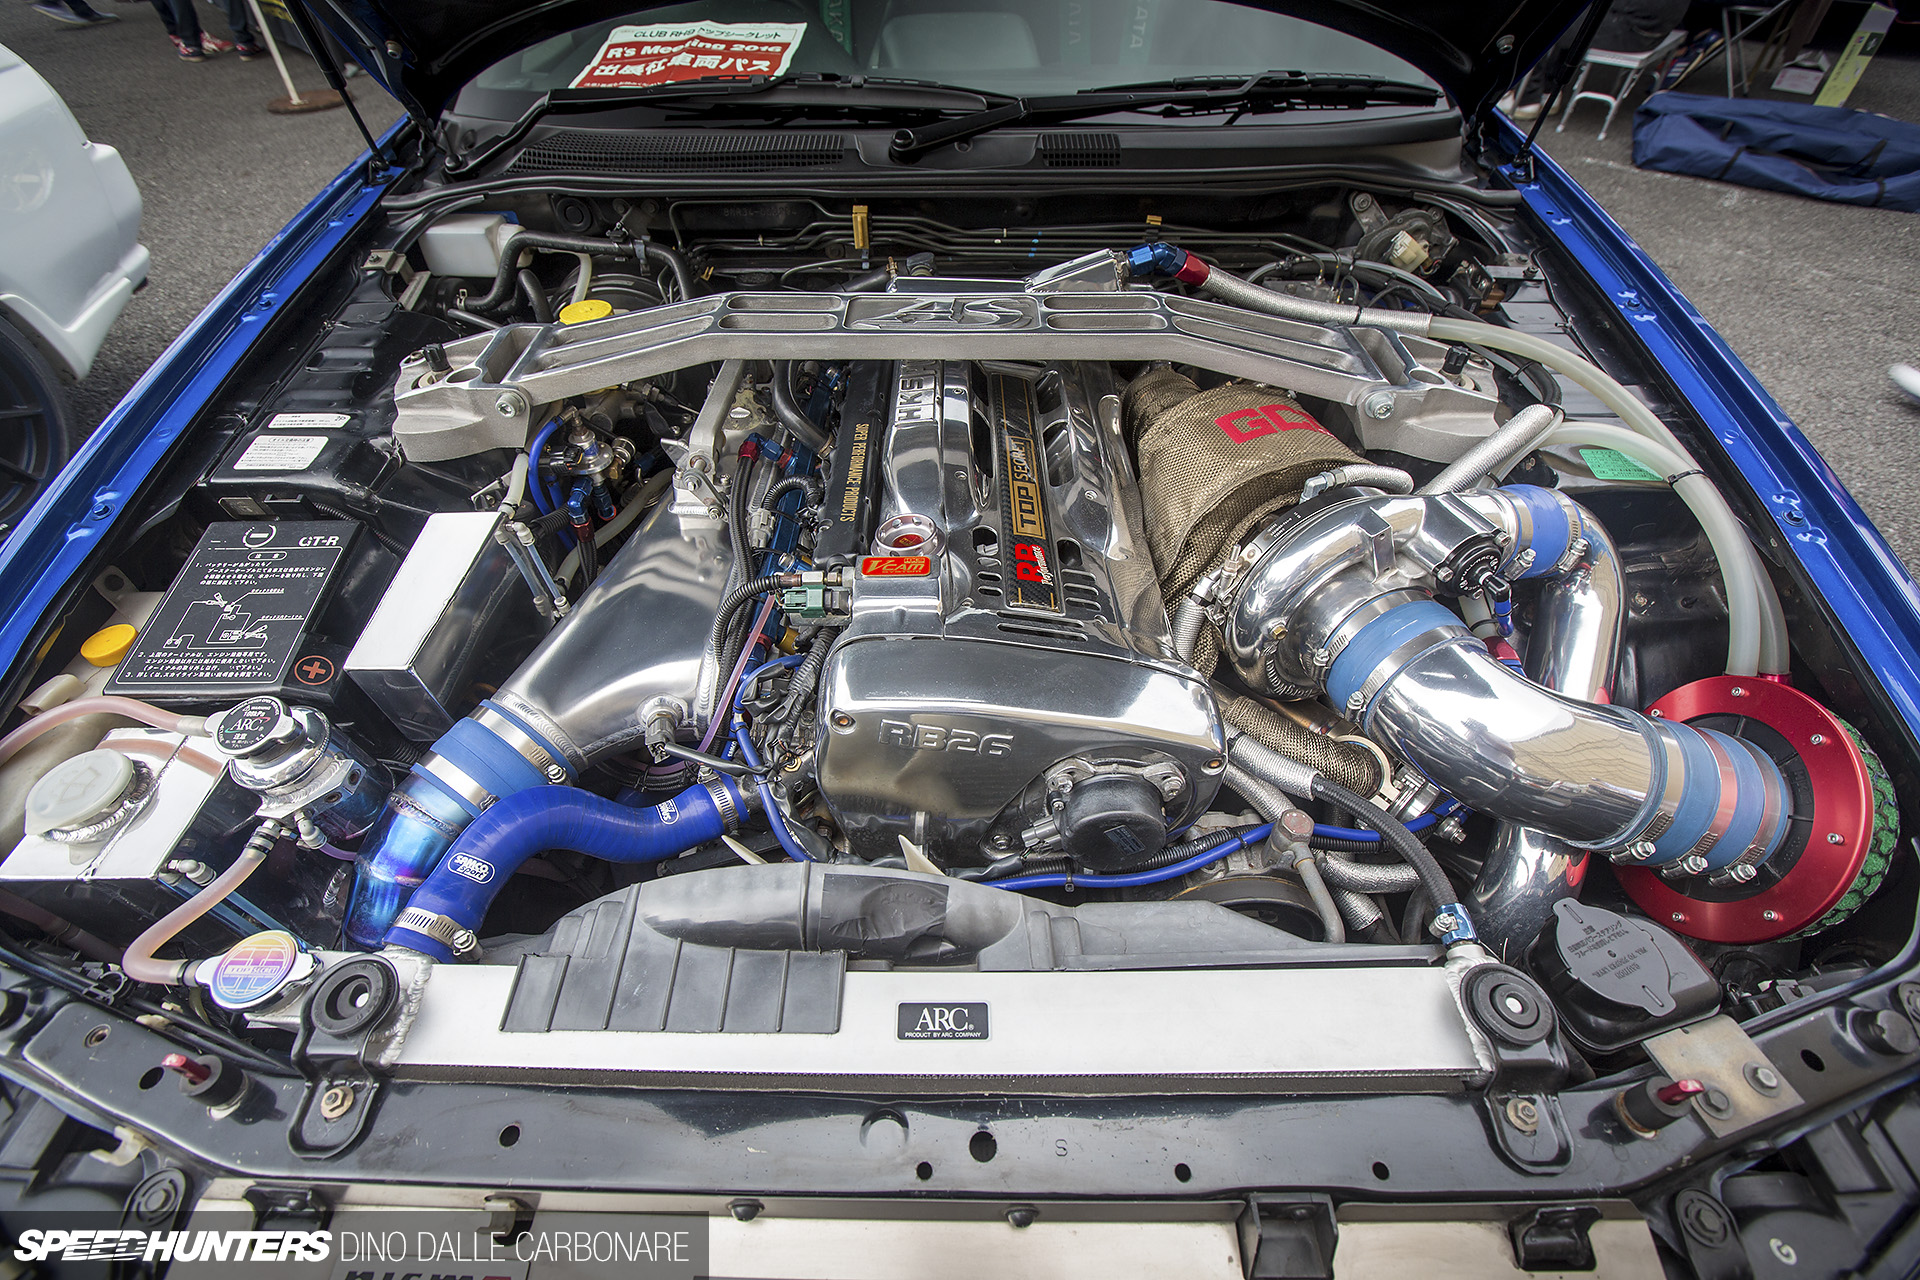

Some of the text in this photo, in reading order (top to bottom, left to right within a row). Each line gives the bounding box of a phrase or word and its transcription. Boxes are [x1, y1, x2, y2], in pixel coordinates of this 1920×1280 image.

[634, 27, 781, 39] CLUB RH9 トップシークレット
[606, 39, 782, 58] R's Meeting 2016
[898, 379, 923, 421] HKS
[840, 423, 870, 522] SUPER PERFORMANCE PRODUCTS
[1017, 486, 1037, 528] TOP
[298, 535, 340, 547] GT-R
[1015, 543, 1046, 583] RB
[1032, 545, 1054, 587] Performance
[230, 718, 263, 731] ARC
[878, 719, 1015, 759] RB26
[454, 855, 489, 874] SAMCO
[460, 865, 485, 880] sport
[1614, 962, 1641, 980] CAUTION
[914, 1007, 969, 1031] ARC
[1055, 1138, 1068, 1157] S
[1769, 1238, 1797, 1265] G
